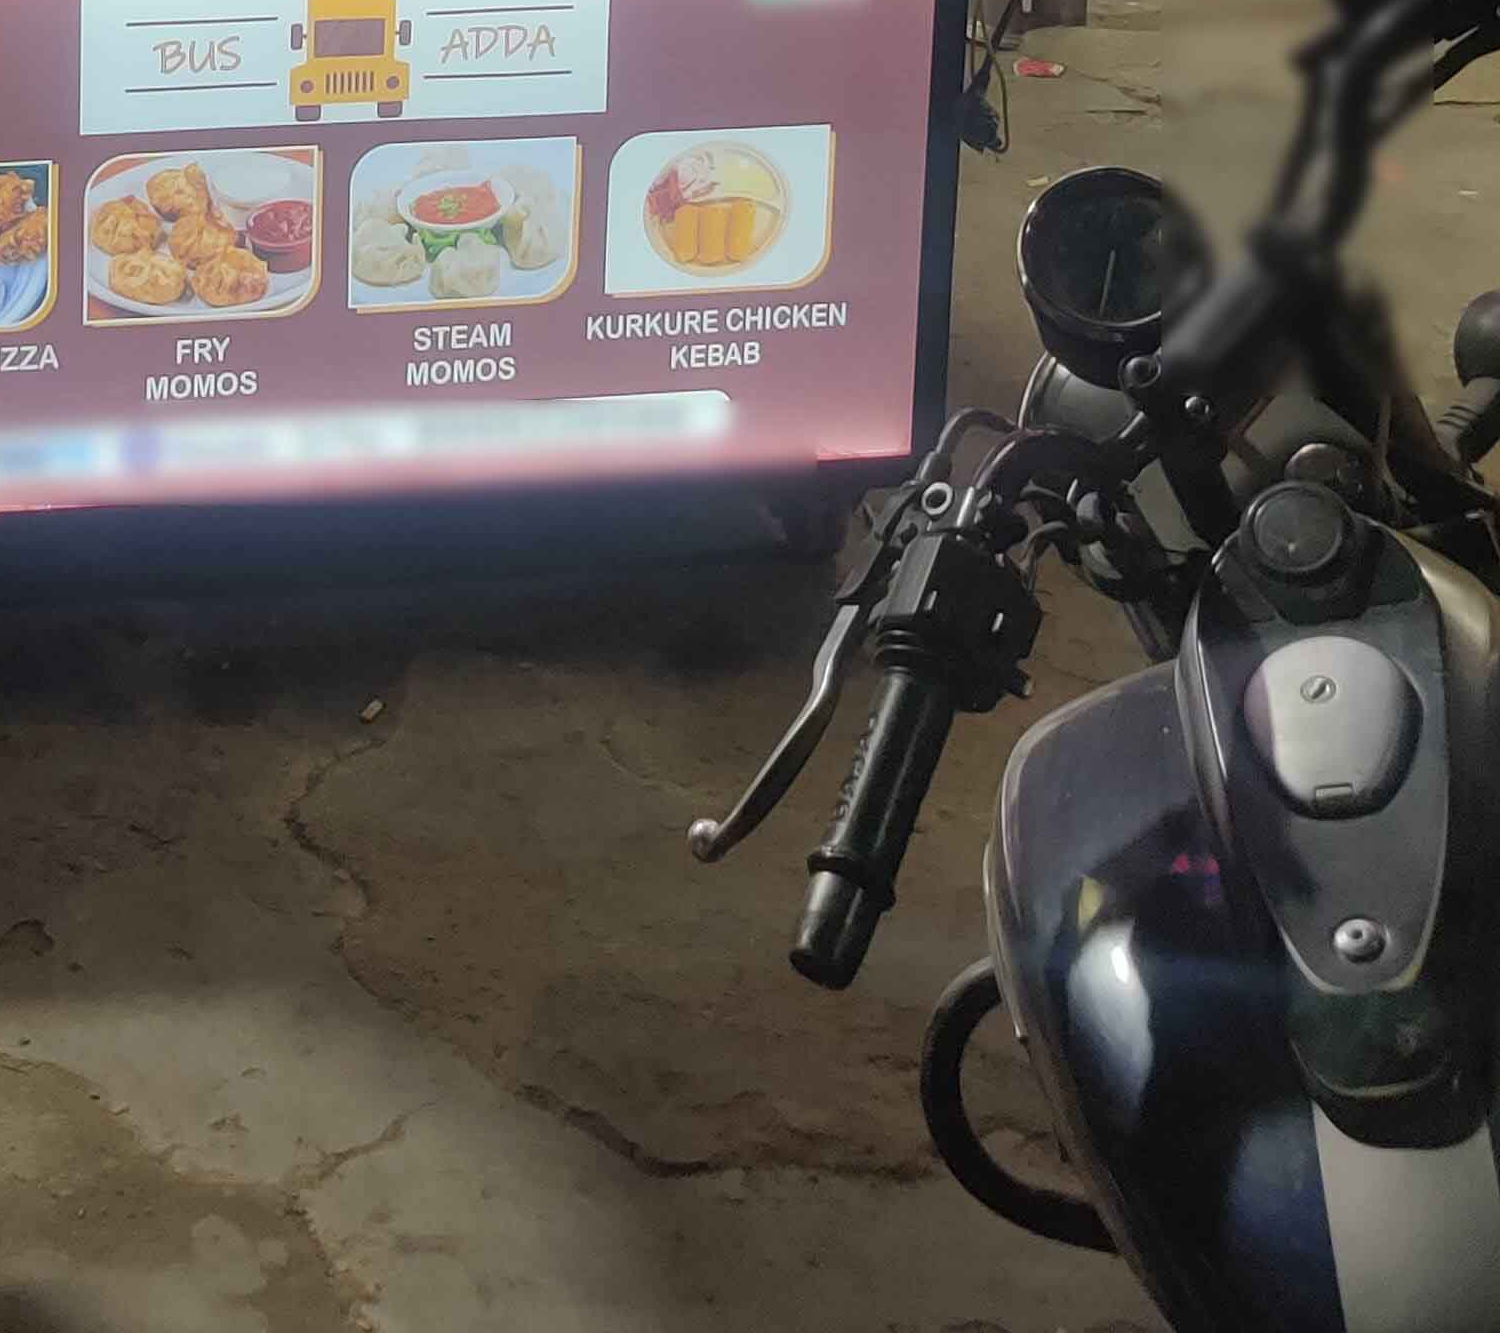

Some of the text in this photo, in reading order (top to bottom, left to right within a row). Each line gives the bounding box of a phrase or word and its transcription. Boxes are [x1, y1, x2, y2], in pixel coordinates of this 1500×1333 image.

[153, 24, 556, 75] BUS ADDA
[585, 302, 848, 341] KURKURE CHICKEN
[175, 336, 231, 365] FRY
[412, 322, 512, 352] STEAM
[670, 340, 761, 370] KEBAB
[145, 371, 258, 401] MOMOS
[406, 356, 517, 387] MOMOS
